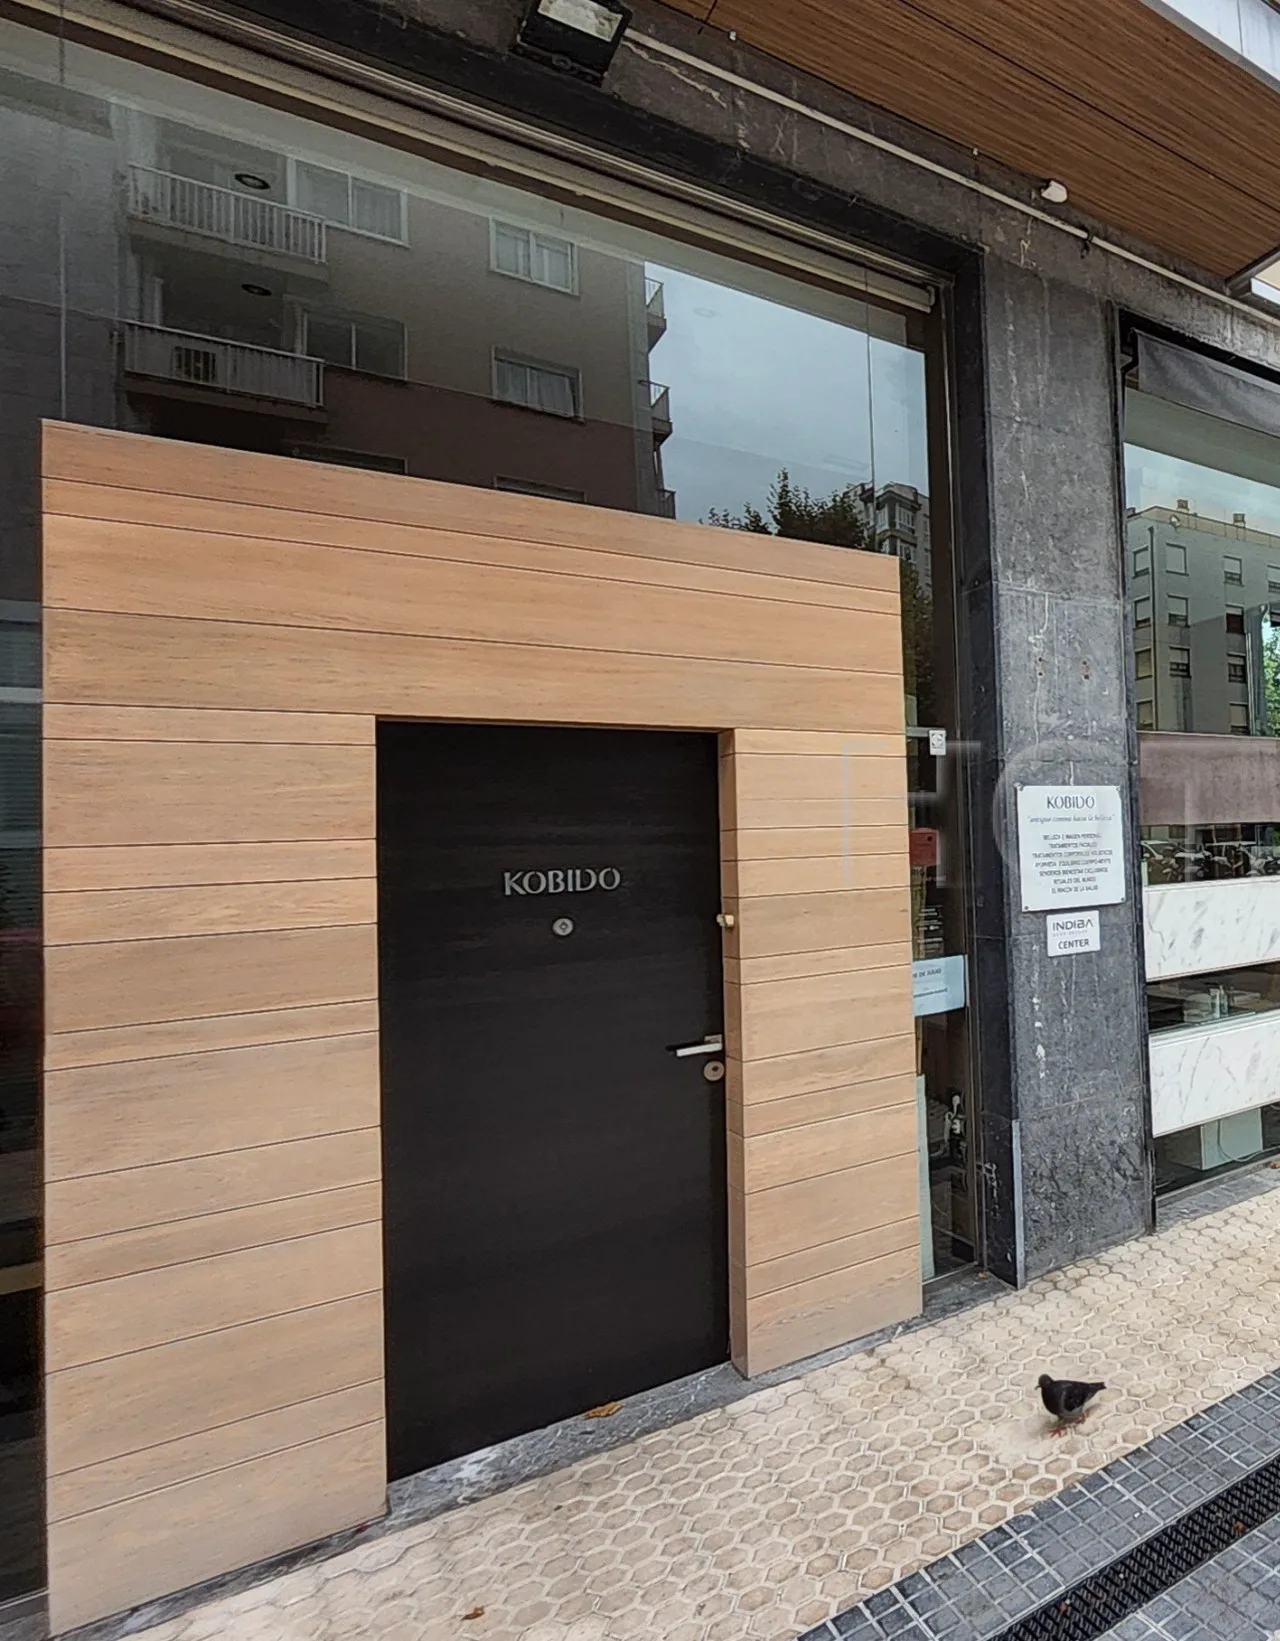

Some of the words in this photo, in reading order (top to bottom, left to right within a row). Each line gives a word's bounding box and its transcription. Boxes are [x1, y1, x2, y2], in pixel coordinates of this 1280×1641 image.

[1046, 795, 1095, 809] KOBIDO
[504, 867, 621, 895] KOBIDO
[1052, 918, 1094, 931] INDIBA
[1058, 938, 1090, 950] CENTER
